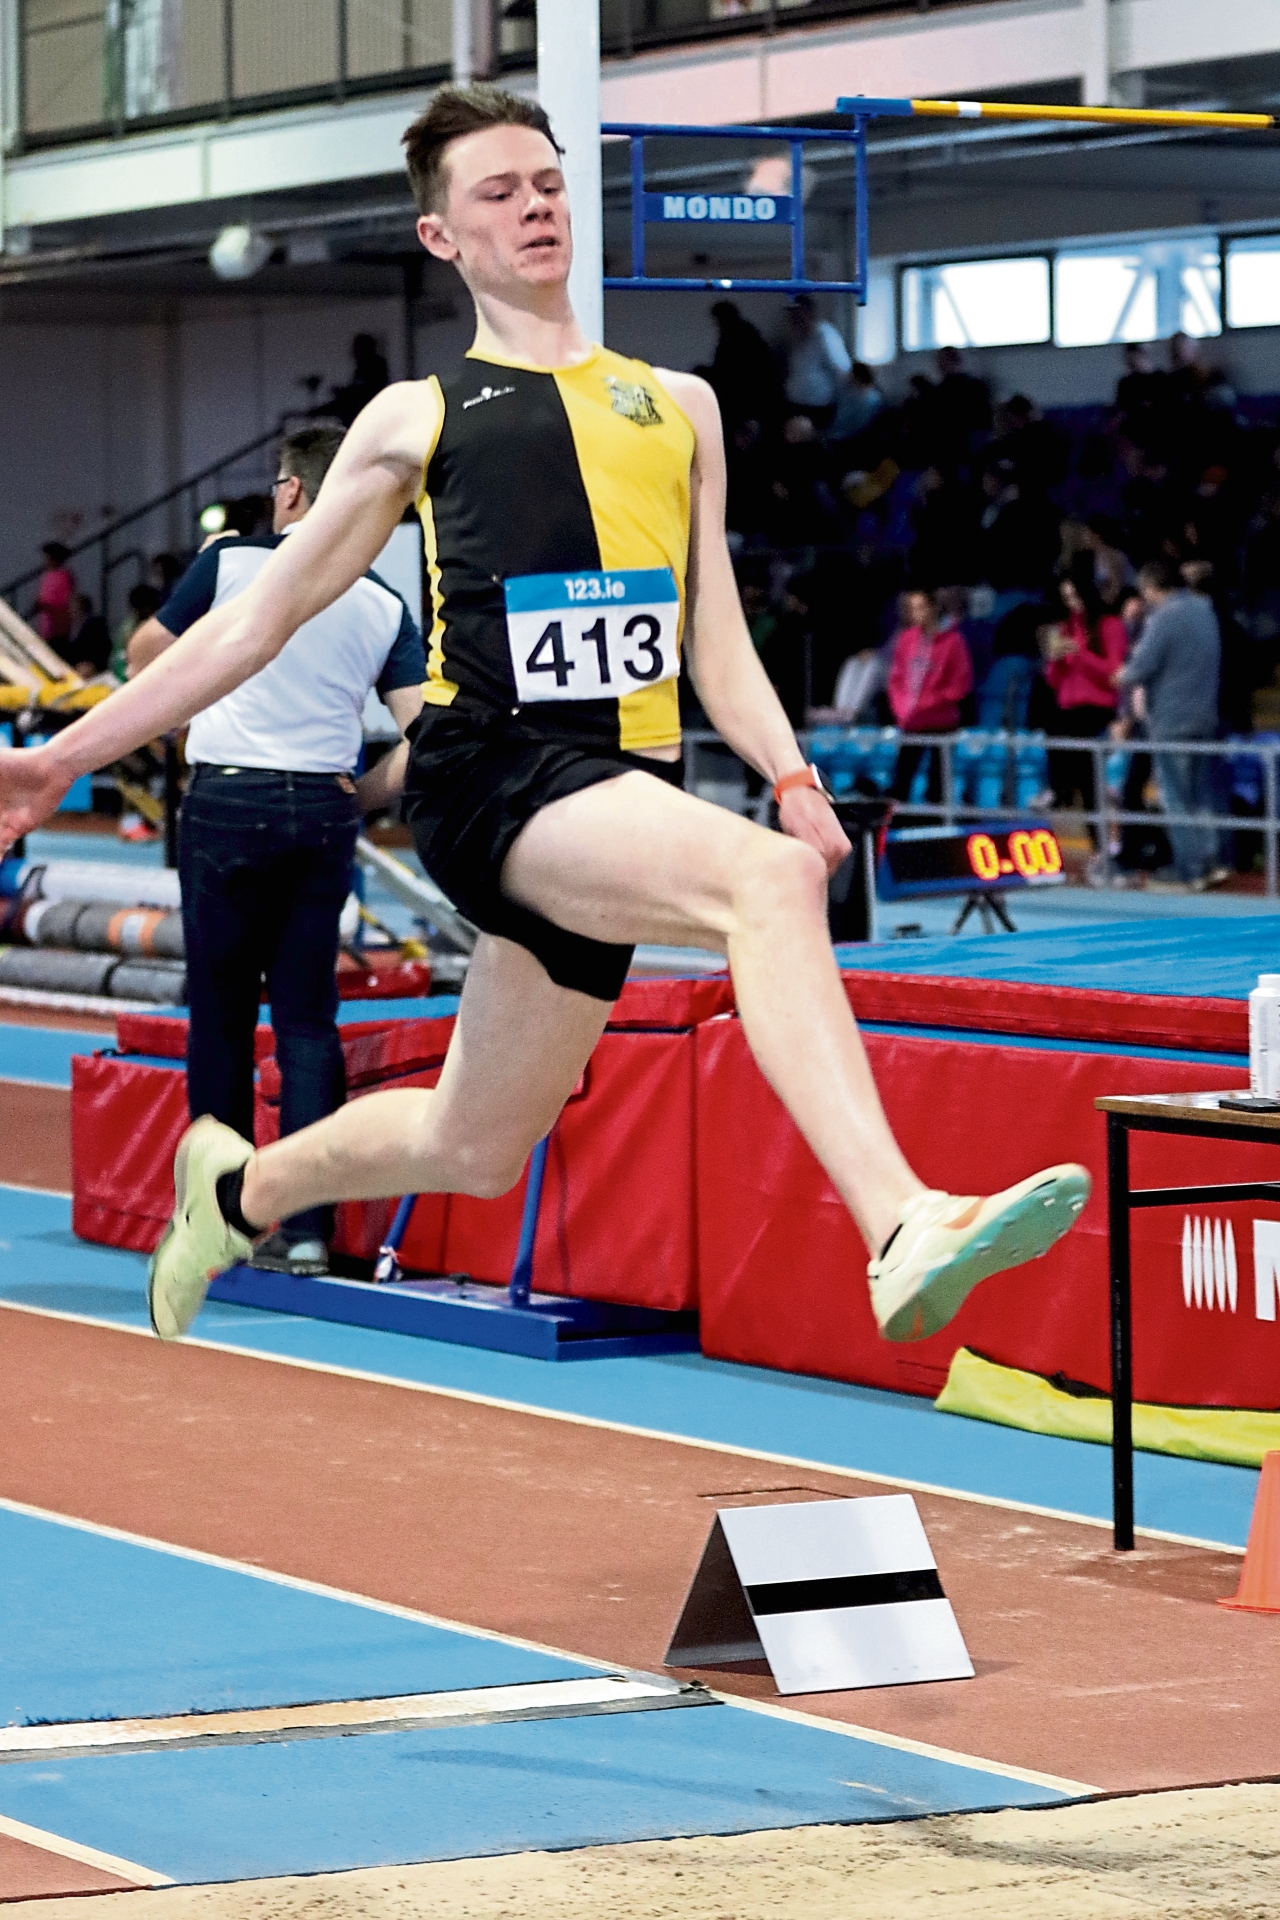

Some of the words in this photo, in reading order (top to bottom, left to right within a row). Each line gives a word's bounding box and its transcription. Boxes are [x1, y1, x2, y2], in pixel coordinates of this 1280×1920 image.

[663, 196, 776, 220] MONDO
[564, 577, 626, 601] 123.ie
[525, 614, 664, 687] 413
[966, 829, 1062, 880] 0.00
